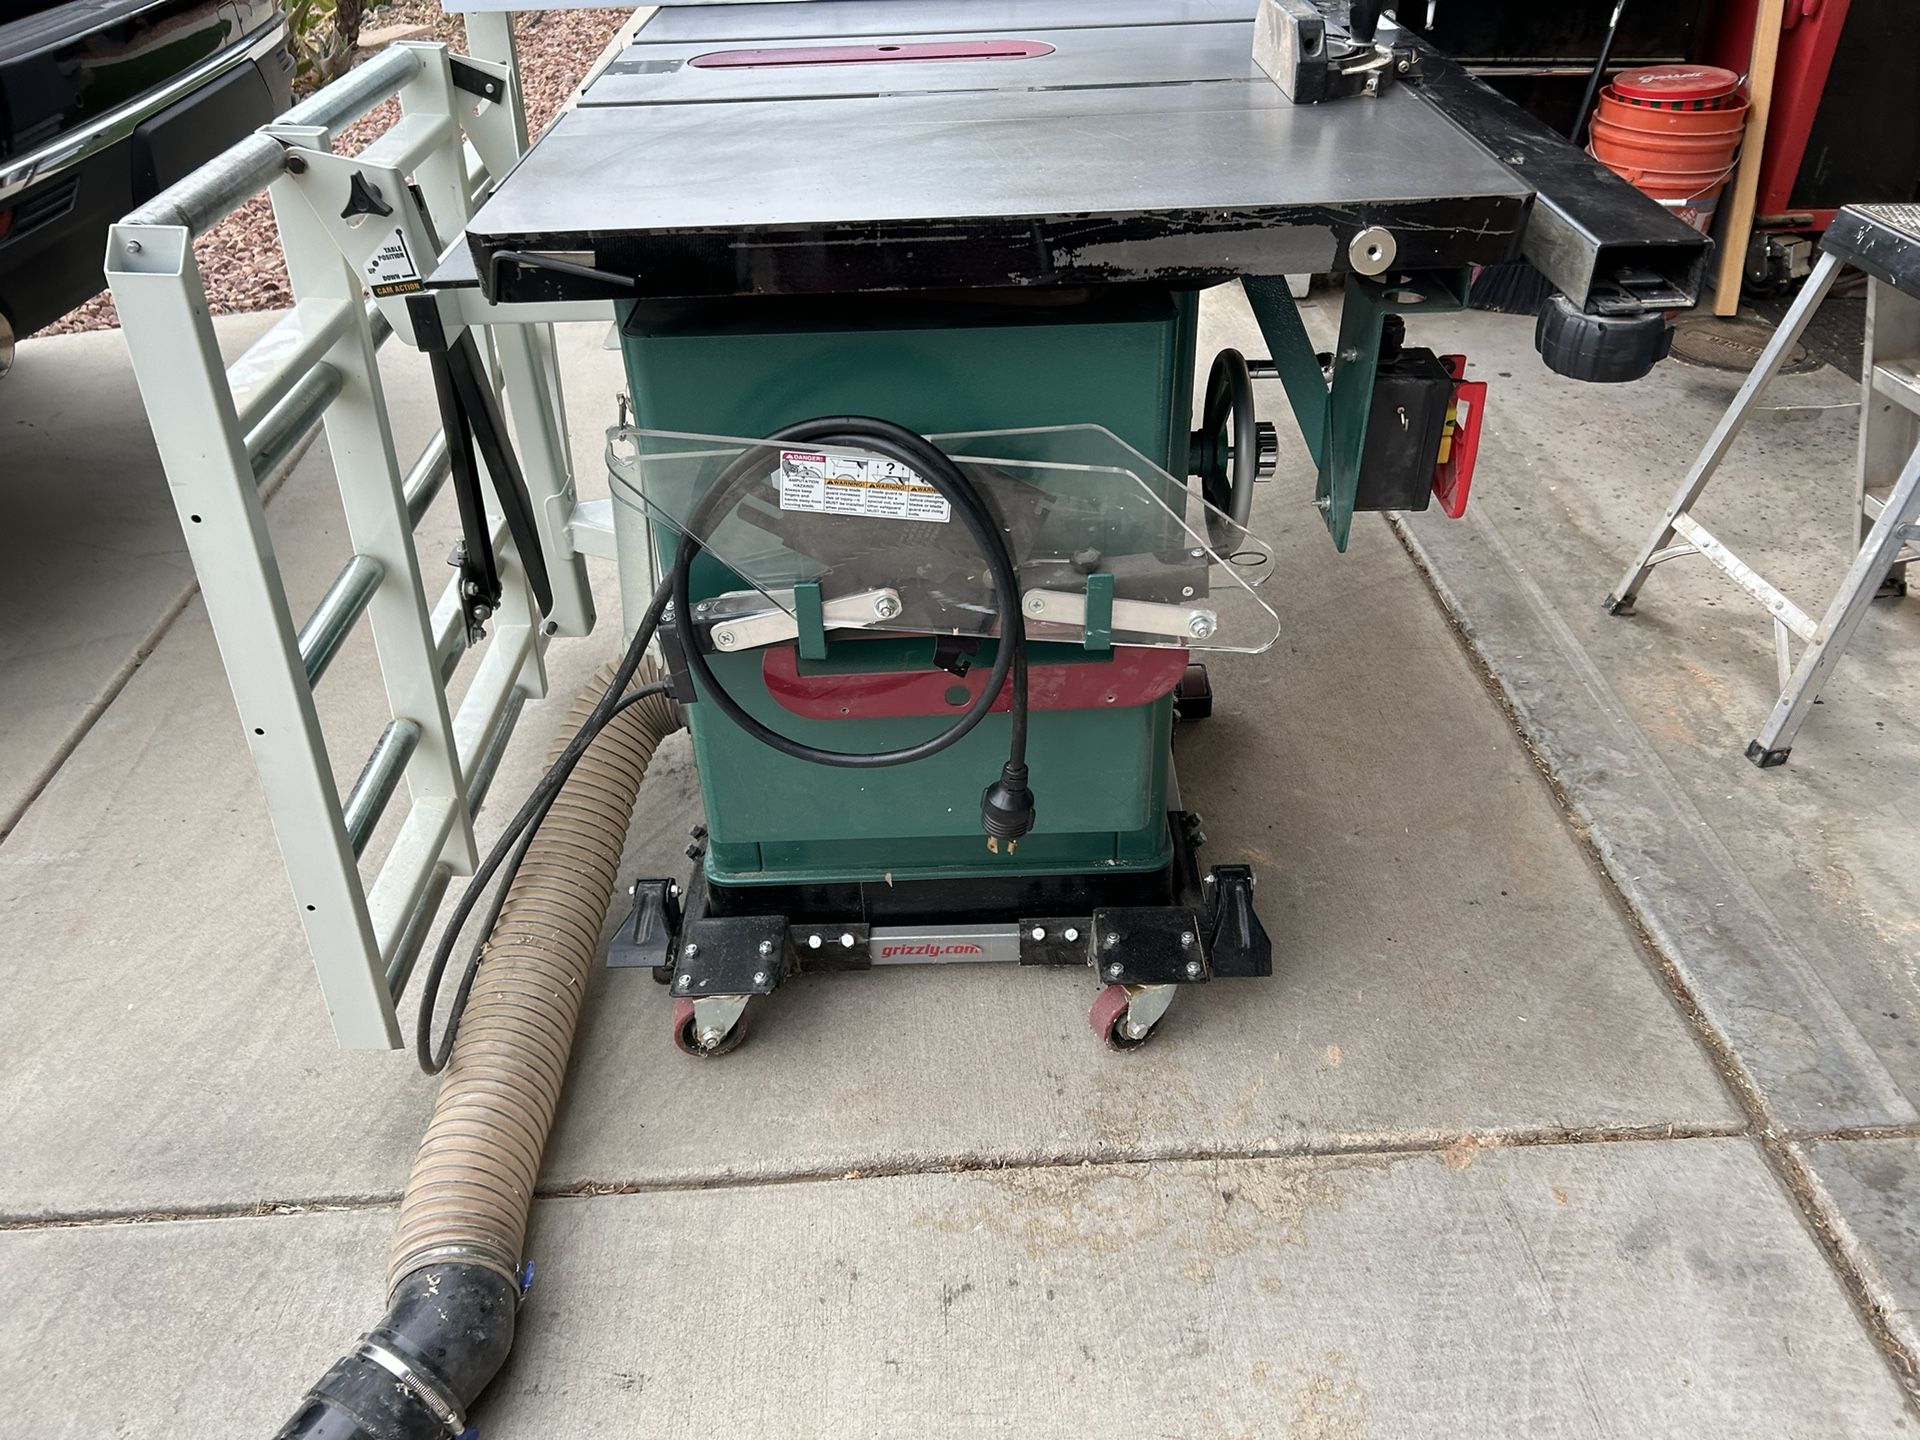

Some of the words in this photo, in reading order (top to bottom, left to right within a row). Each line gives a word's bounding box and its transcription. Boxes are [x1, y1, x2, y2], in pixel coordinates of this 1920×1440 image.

[377, 252, 405, 261] POSITION
[377, 286, 393, 295] CAM
[394, 282, 420, 292] ACTION
[876, 483, 907, 491] WARNING!
[881, 943, 983, 958] grizzly.com
